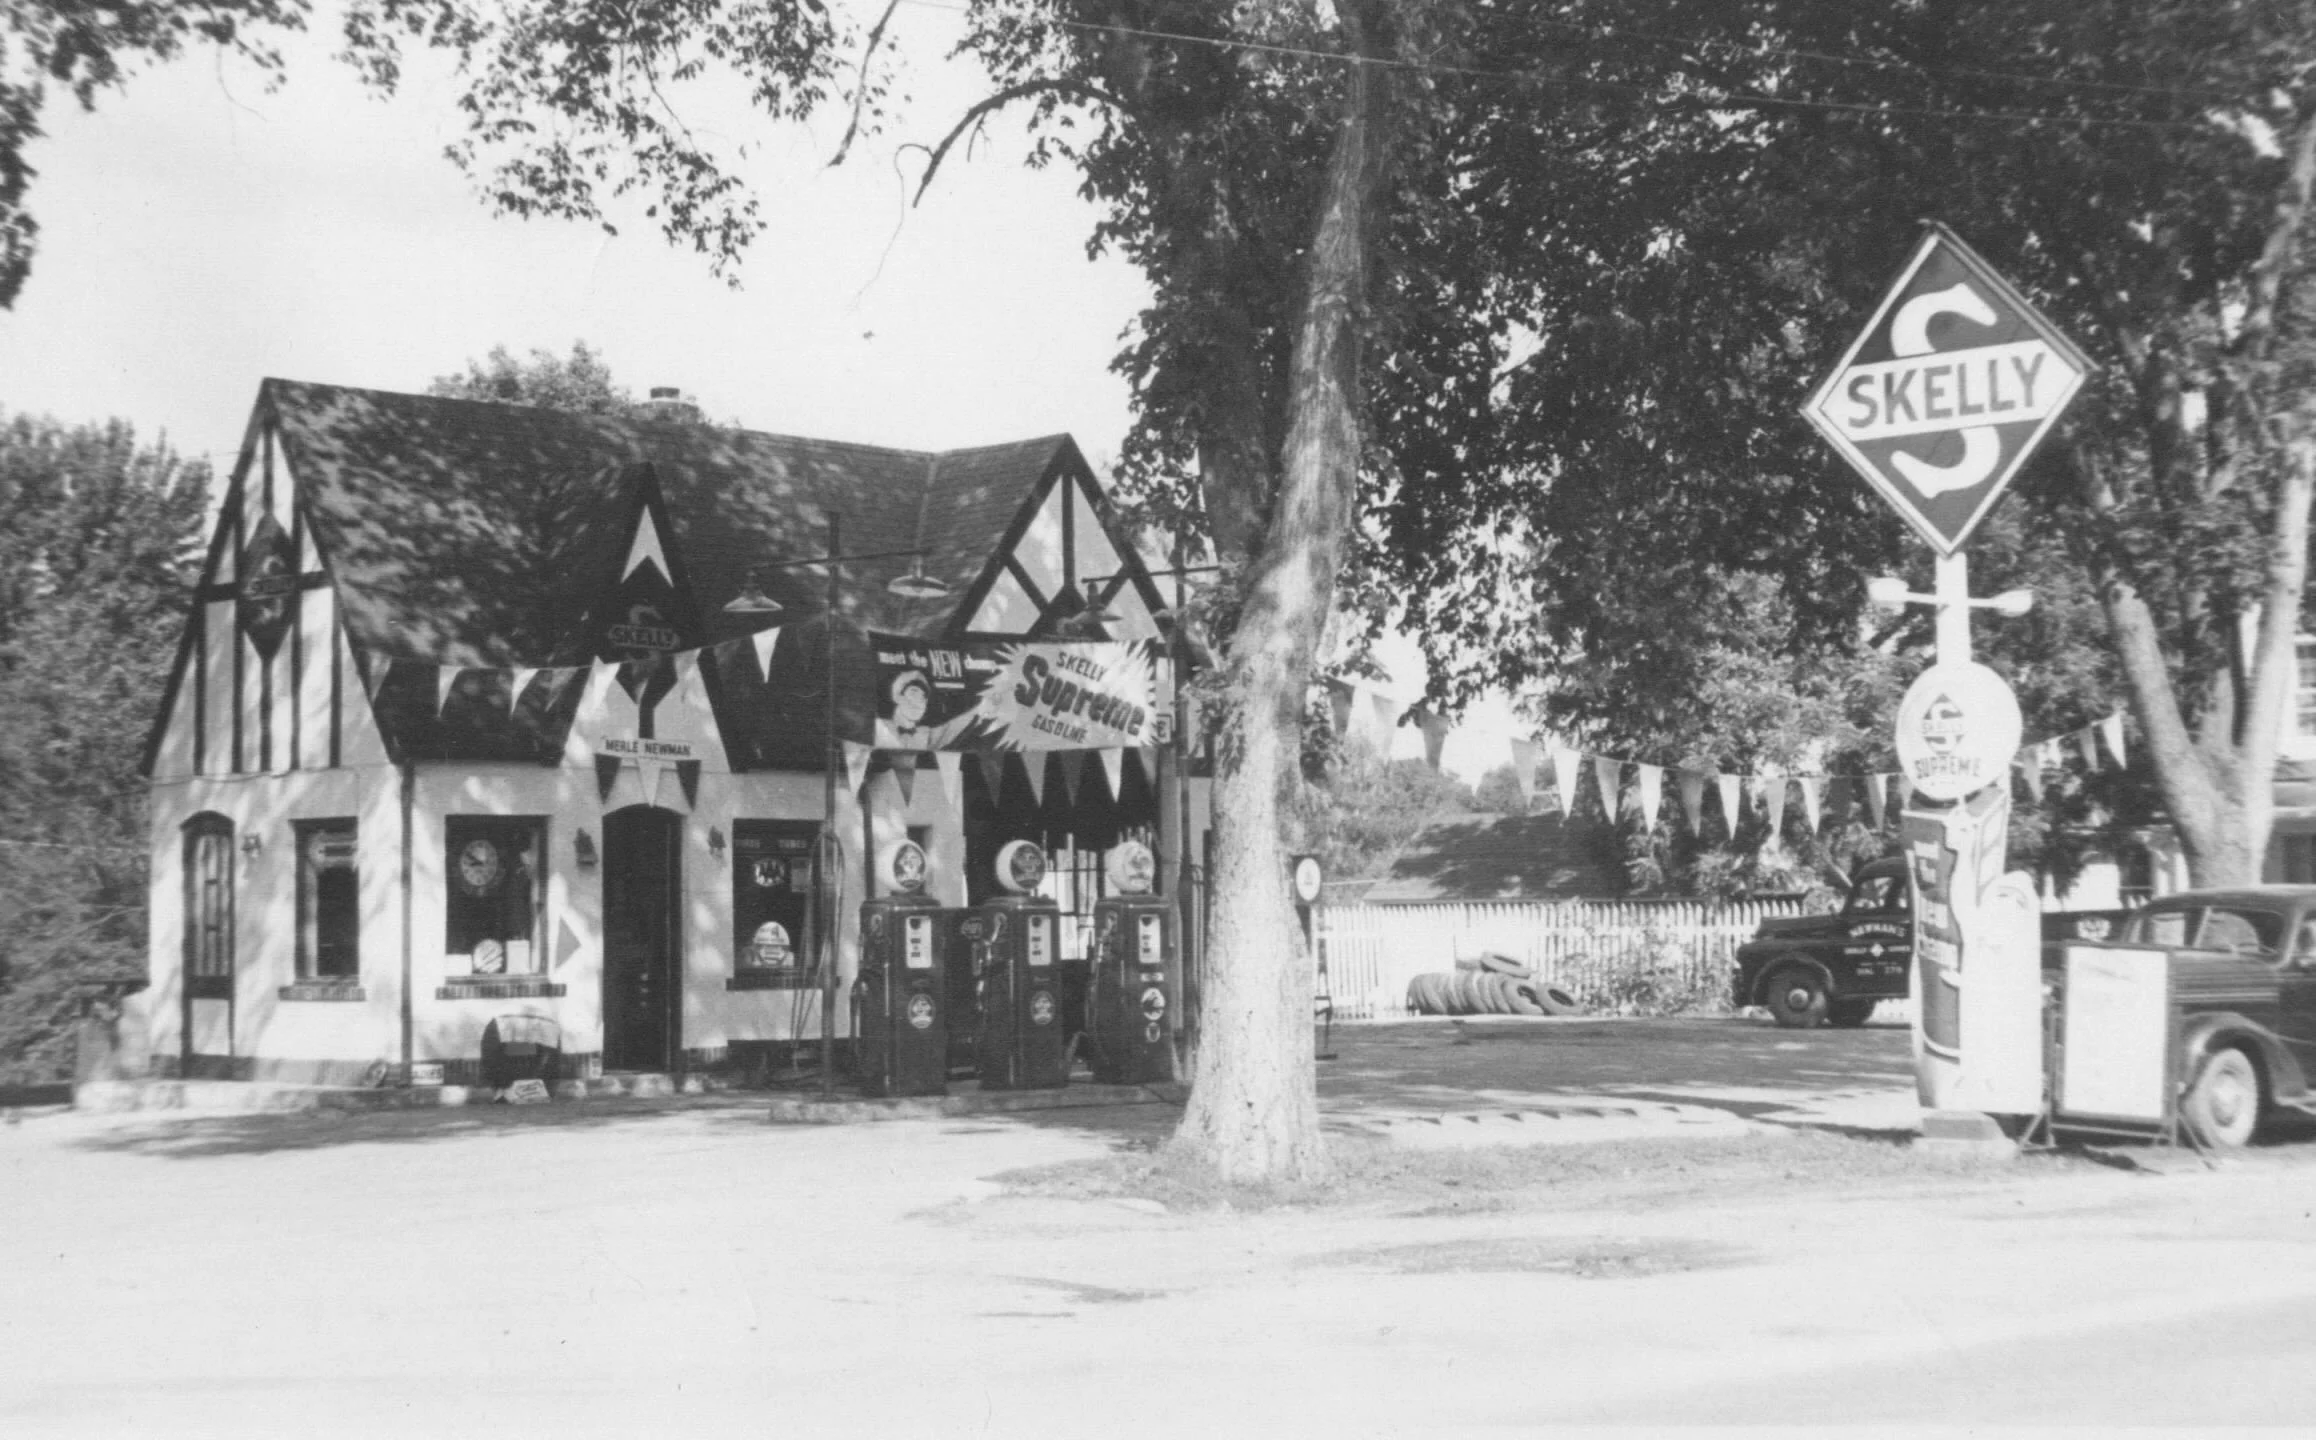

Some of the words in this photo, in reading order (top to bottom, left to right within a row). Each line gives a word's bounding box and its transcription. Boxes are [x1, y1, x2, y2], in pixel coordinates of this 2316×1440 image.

[1847, 351, 2047, 430] SKELLY
[928, 649, 962, 677] NEW
[1056, 651, 1107, 682] SKELLY
[1013, 654, 1145, 737] Supreme
[1031, 714, 1088, 744] GASOLINE
[605, 739, 639, 753] MERLE
[644, 742, 691, 756] NEWMAN
[1914, 757, 1981, 780] SUPREME
